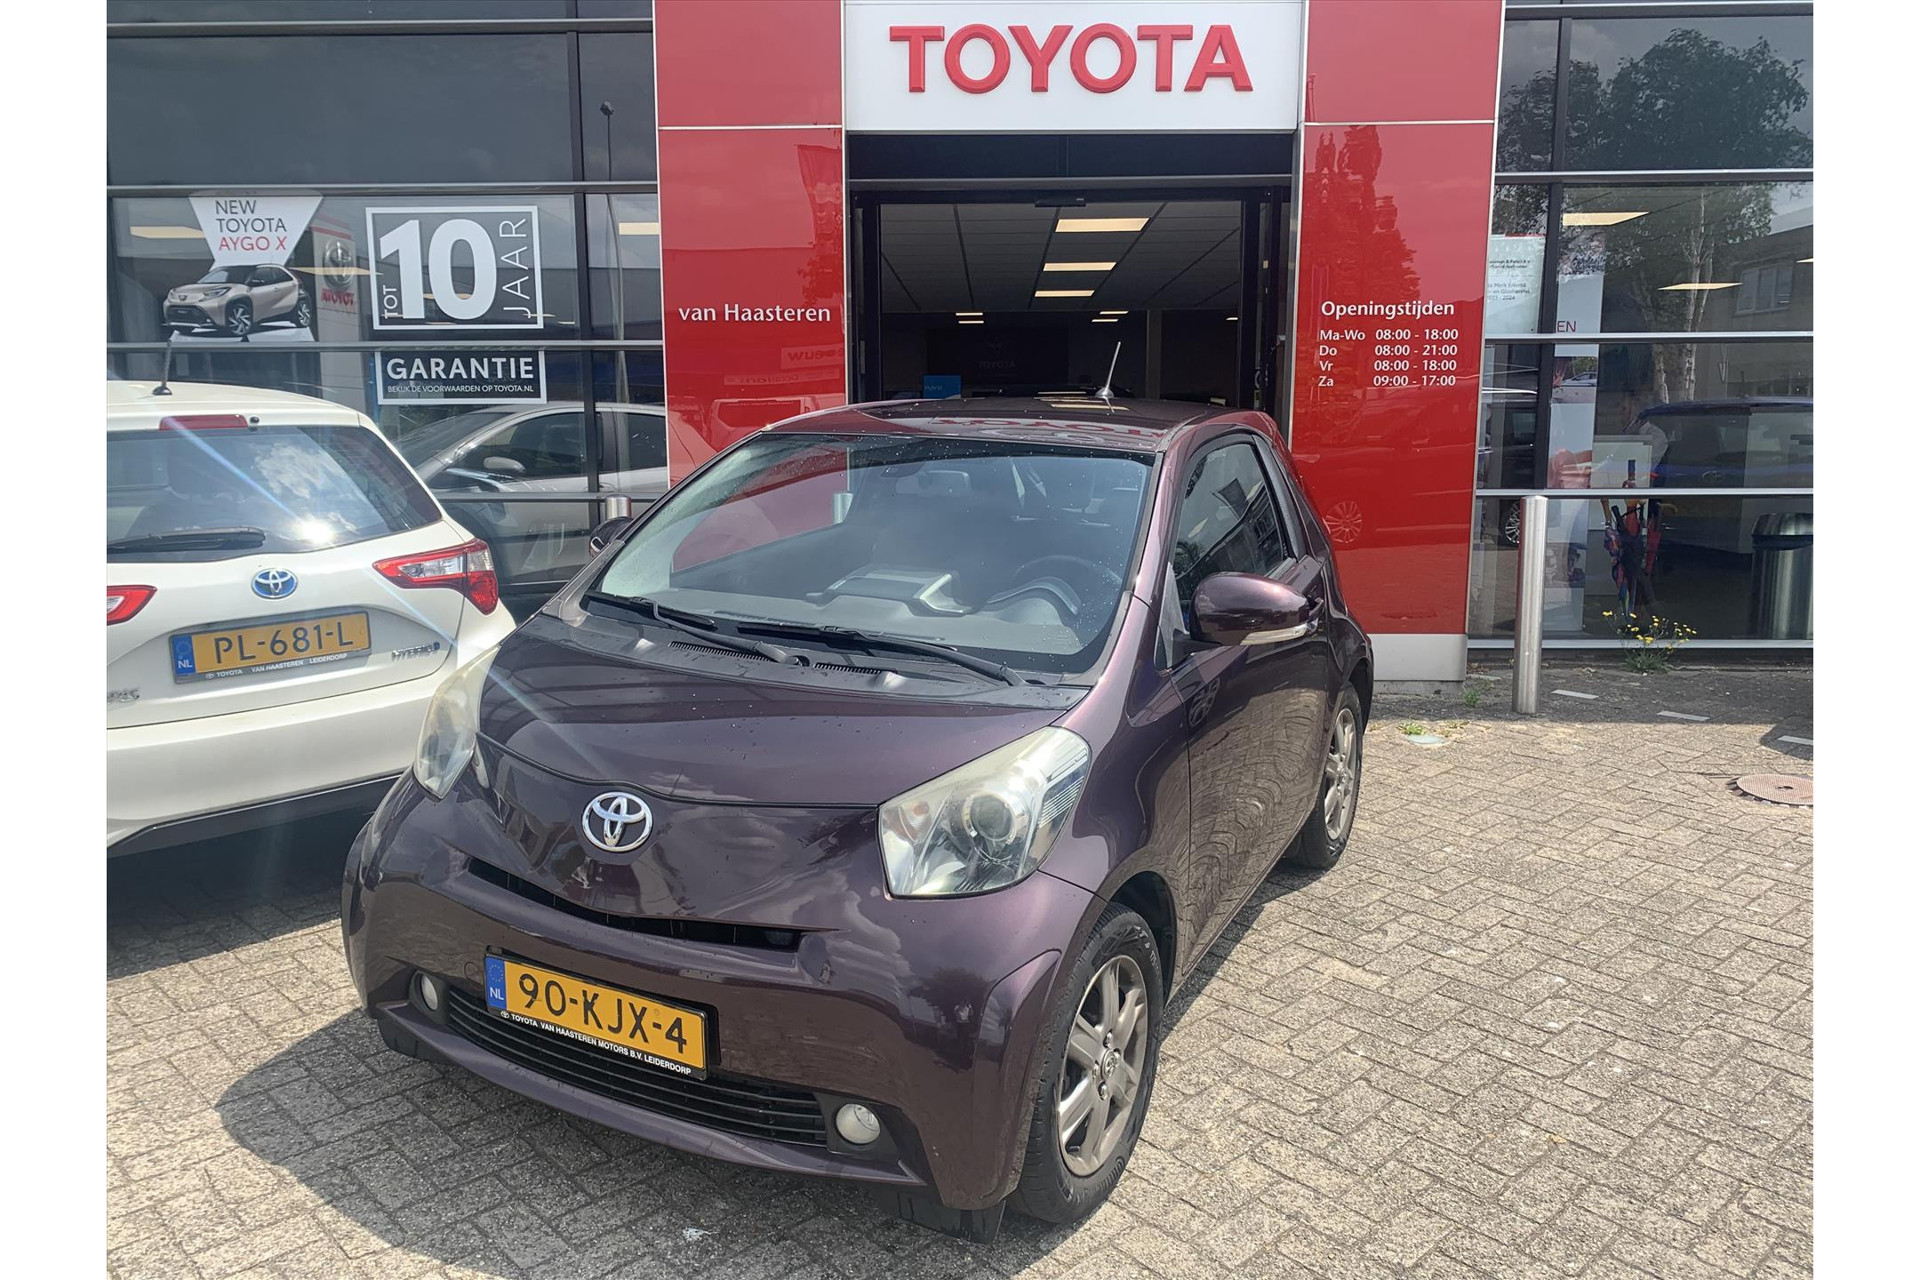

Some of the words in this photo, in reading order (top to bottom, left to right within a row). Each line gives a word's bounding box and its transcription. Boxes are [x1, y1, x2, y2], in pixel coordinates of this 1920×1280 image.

[889, 23, 1253, 93] TOYOTA
[215, 200, 256, 214] NEW
[216, 218, 287, 233] TOYOTA
[219, 236, 270, 250] AYGO
[276, 236, 287, 250] X
[380, 218, 497, 320] 10
[499, 218, 531, 318] JAAR
[383, 285, 399, 319] TOT
[1321, 300, 1455, 320] Openingstijden
[678, 307, 716, 321] van
[724, 303, 831, 322] Haasteren
[1320, 329, 1366, 341] Ma-Wo
[1375, 329, 1411, 340] 08:00
[1424, 329, 1459, 340] 18:00
[1319, 345, 1337, 356] Do
[1374, 345, 1410, 356] 08:00
[1422, 344, 1458, 356] 21:00
[386, 358, 534, 380] GARANTIE
[1319, 360, 1334, 371] Vr
[1373, 360, 1409, 371] 08:00
[1422, 360, 1457, 371] 18:00
[411, 385, 421, 393] DE
[423, 385, 481, 393] VOORWAARDEN
[482, 385, 493, 393] OP
[494, 385, 534, 393] TOYOTA.NL
[1318, 375, 1334, 387] Za
[1373, 375, 1409, 386] 09:00
[1421, 375, 1456, 386] 17:00
[213, 621, 353, 664] PL-681-L
[177, 659, 193, 669] NL
[216, 669, 243, 678] TOYOTA
[266, 660, 304, 671] HAASTEREN
[309, 653, 348, 664] LEIDERDORP
[489, 987, 505, 1001] NL
[518, 973, 688, 1054] 90-KJX-4
[511, 1013, 538, 1027] TOYOTA
[540, 1021, 555, 1033] VAN
[555, 1025, 597, 1046] HAASTEREN
[598, 1038, 629, 1056] MOTORS
[630, 1047, 643, 1061] B.V.
[644, 1054, 692, 1075] LEIDERDORP
